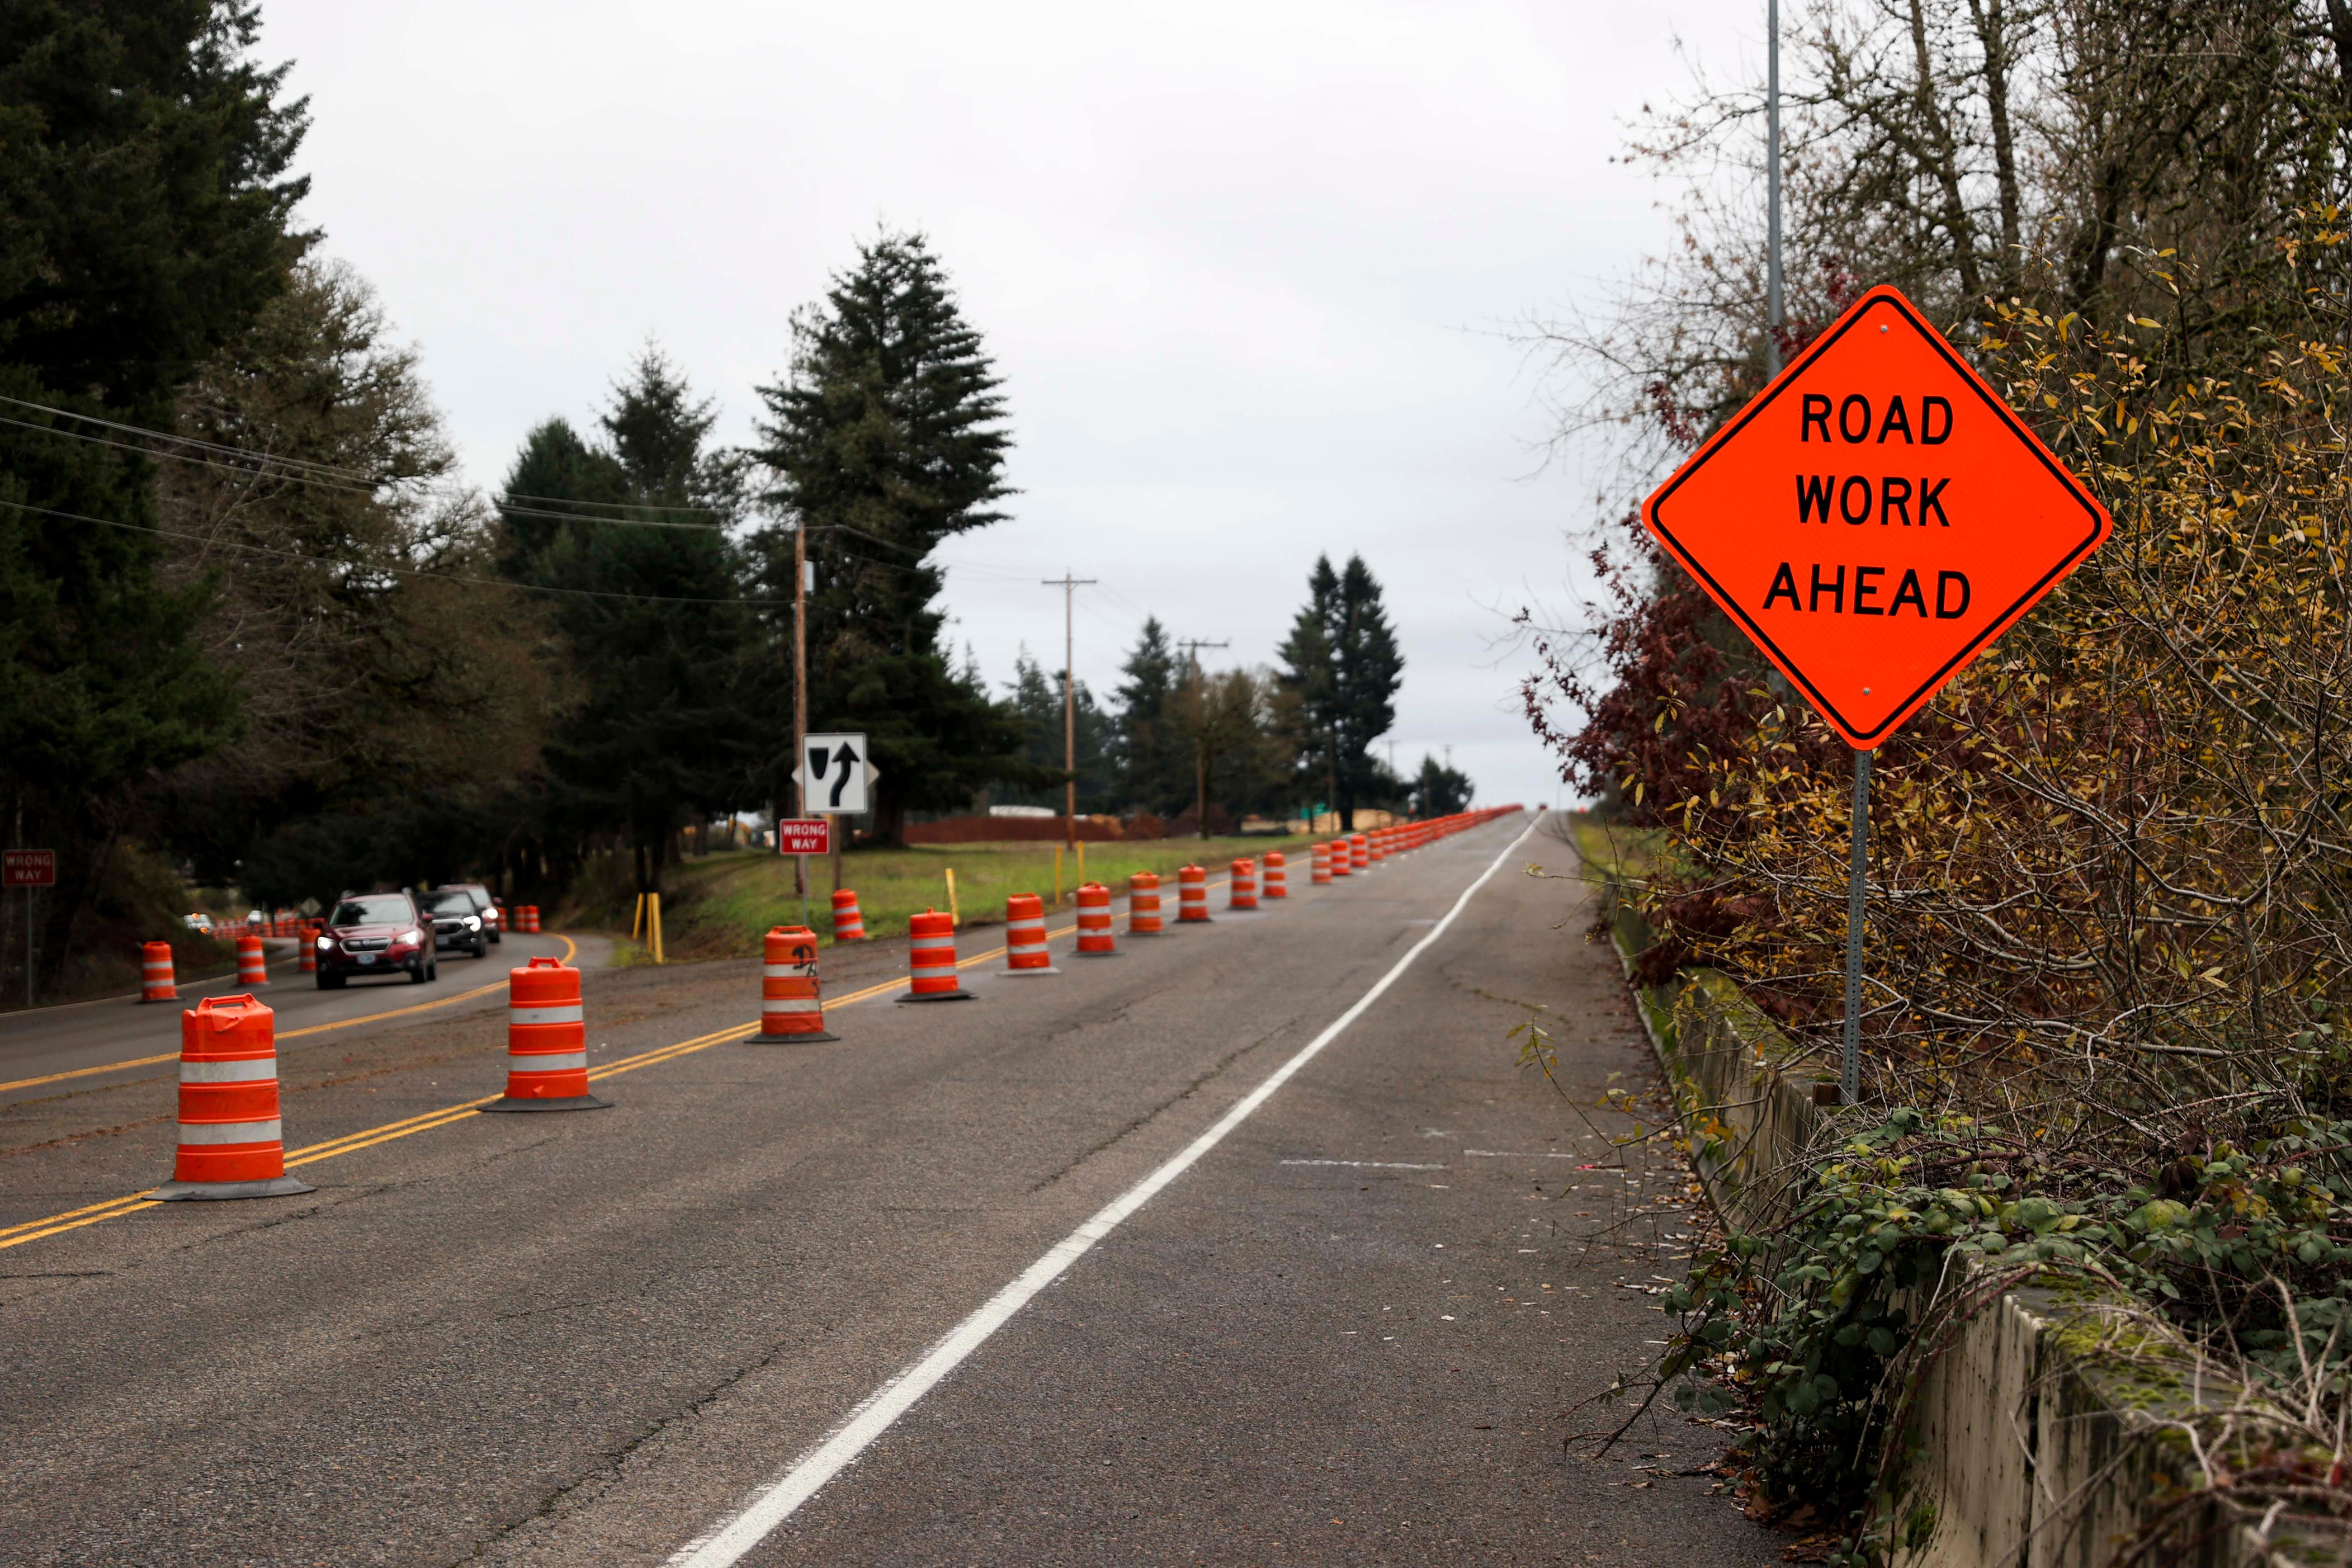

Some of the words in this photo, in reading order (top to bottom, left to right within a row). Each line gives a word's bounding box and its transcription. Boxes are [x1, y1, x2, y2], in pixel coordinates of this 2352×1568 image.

[1801, 394, 1953, 445] ROAD
[1796, 475, 1950, 527] WORK
[1762, 562, 1971, 619] AHEAD
[783, 824, 826, 836] WRONG
[791, 839, 818, 849] WAY
[6, 855, 51, 866] WRONG
[15, 870, 42, 880] WAY
